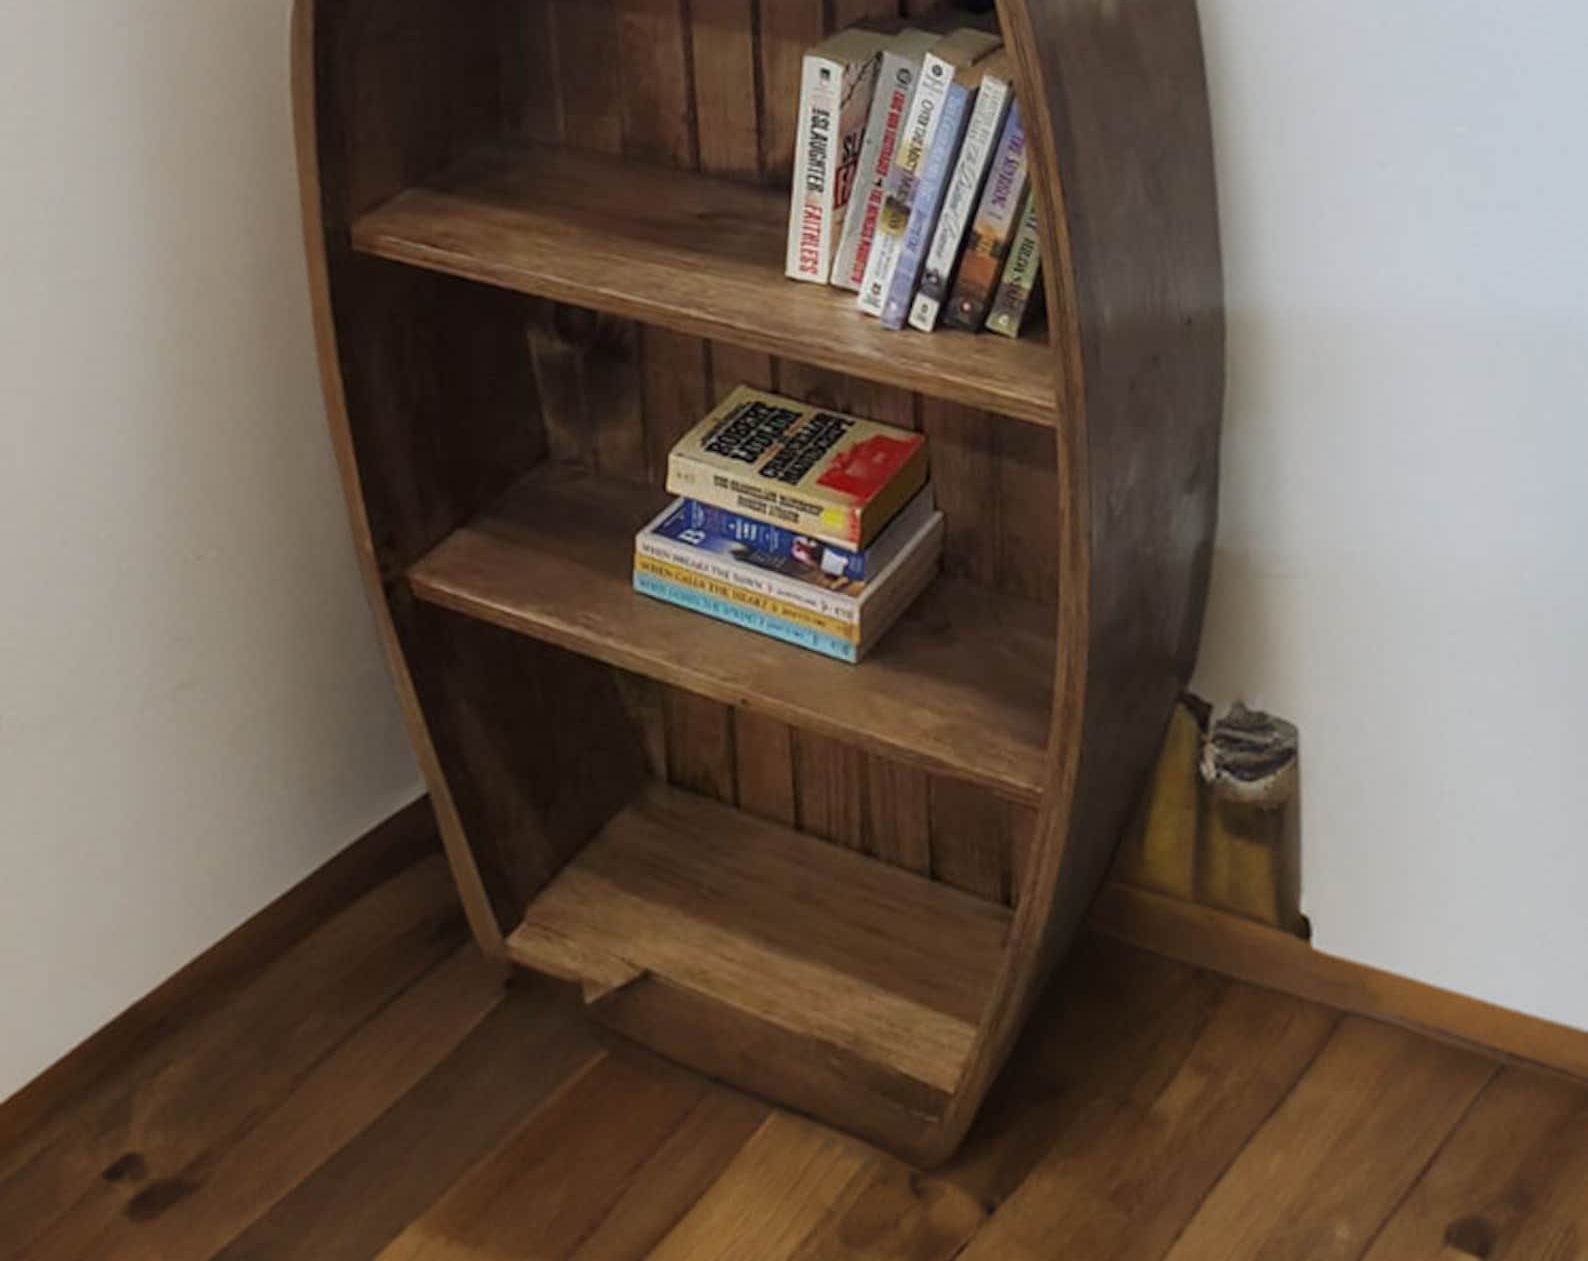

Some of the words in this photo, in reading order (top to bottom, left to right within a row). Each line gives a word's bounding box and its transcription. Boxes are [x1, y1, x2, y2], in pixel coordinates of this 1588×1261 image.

[807, 113, 829, 193] SLAUGHTER
[800, 204, 823, 275] FAITHLESS
[708, 582, 728, 595] THE
